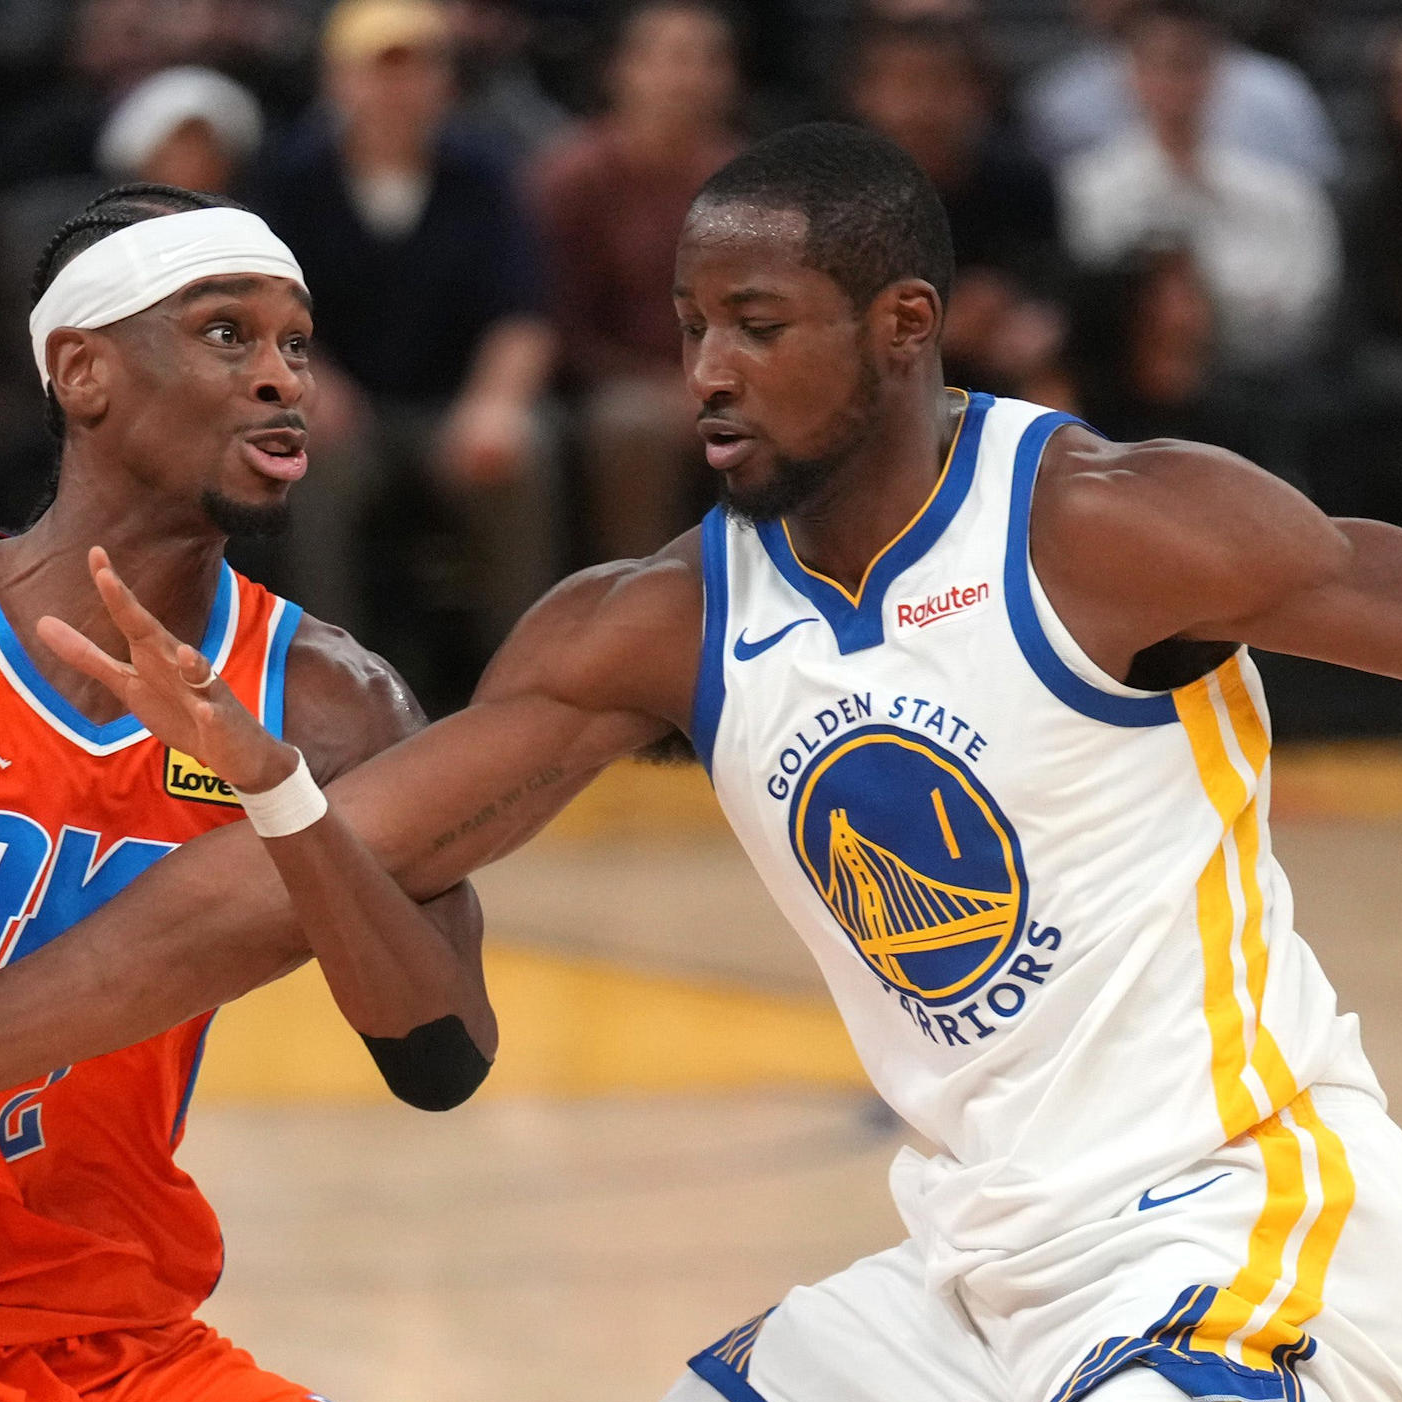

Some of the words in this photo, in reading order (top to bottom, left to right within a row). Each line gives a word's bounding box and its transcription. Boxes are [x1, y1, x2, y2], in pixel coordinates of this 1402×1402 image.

[897, 582, 990, 628] Rakuten
[767, 691, 872, 801] GOLDEN
[888, 695, 989, 763] STATE
[877, 920, 1062, 1047] ARRIORS
